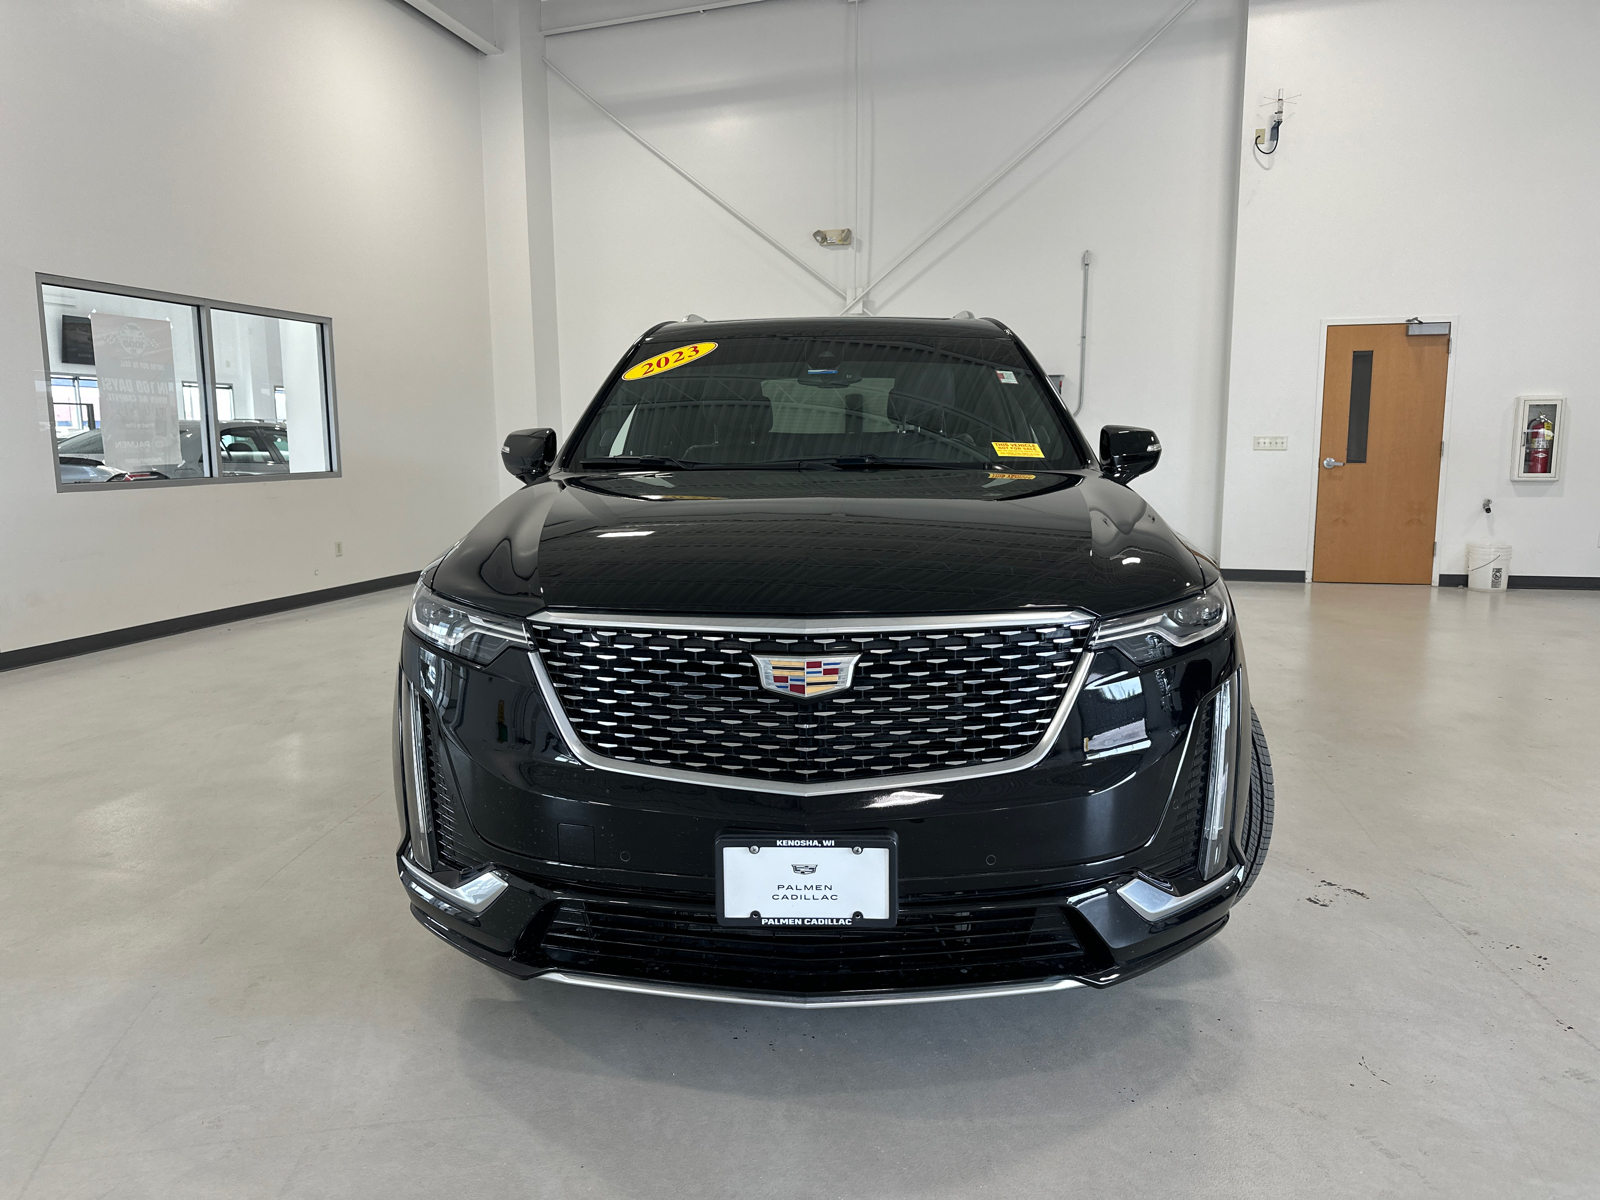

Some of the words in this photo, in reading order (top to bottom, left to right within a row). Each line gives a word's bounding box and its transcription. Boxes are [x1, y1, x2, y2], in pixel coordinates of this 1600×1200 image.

[641, 346, 699, 375] 2023
[776, 839, 821, 847] KENOSHA,
[823, 839, 835, 847] WI
[804, 918, 853, 926] CADILLAC
